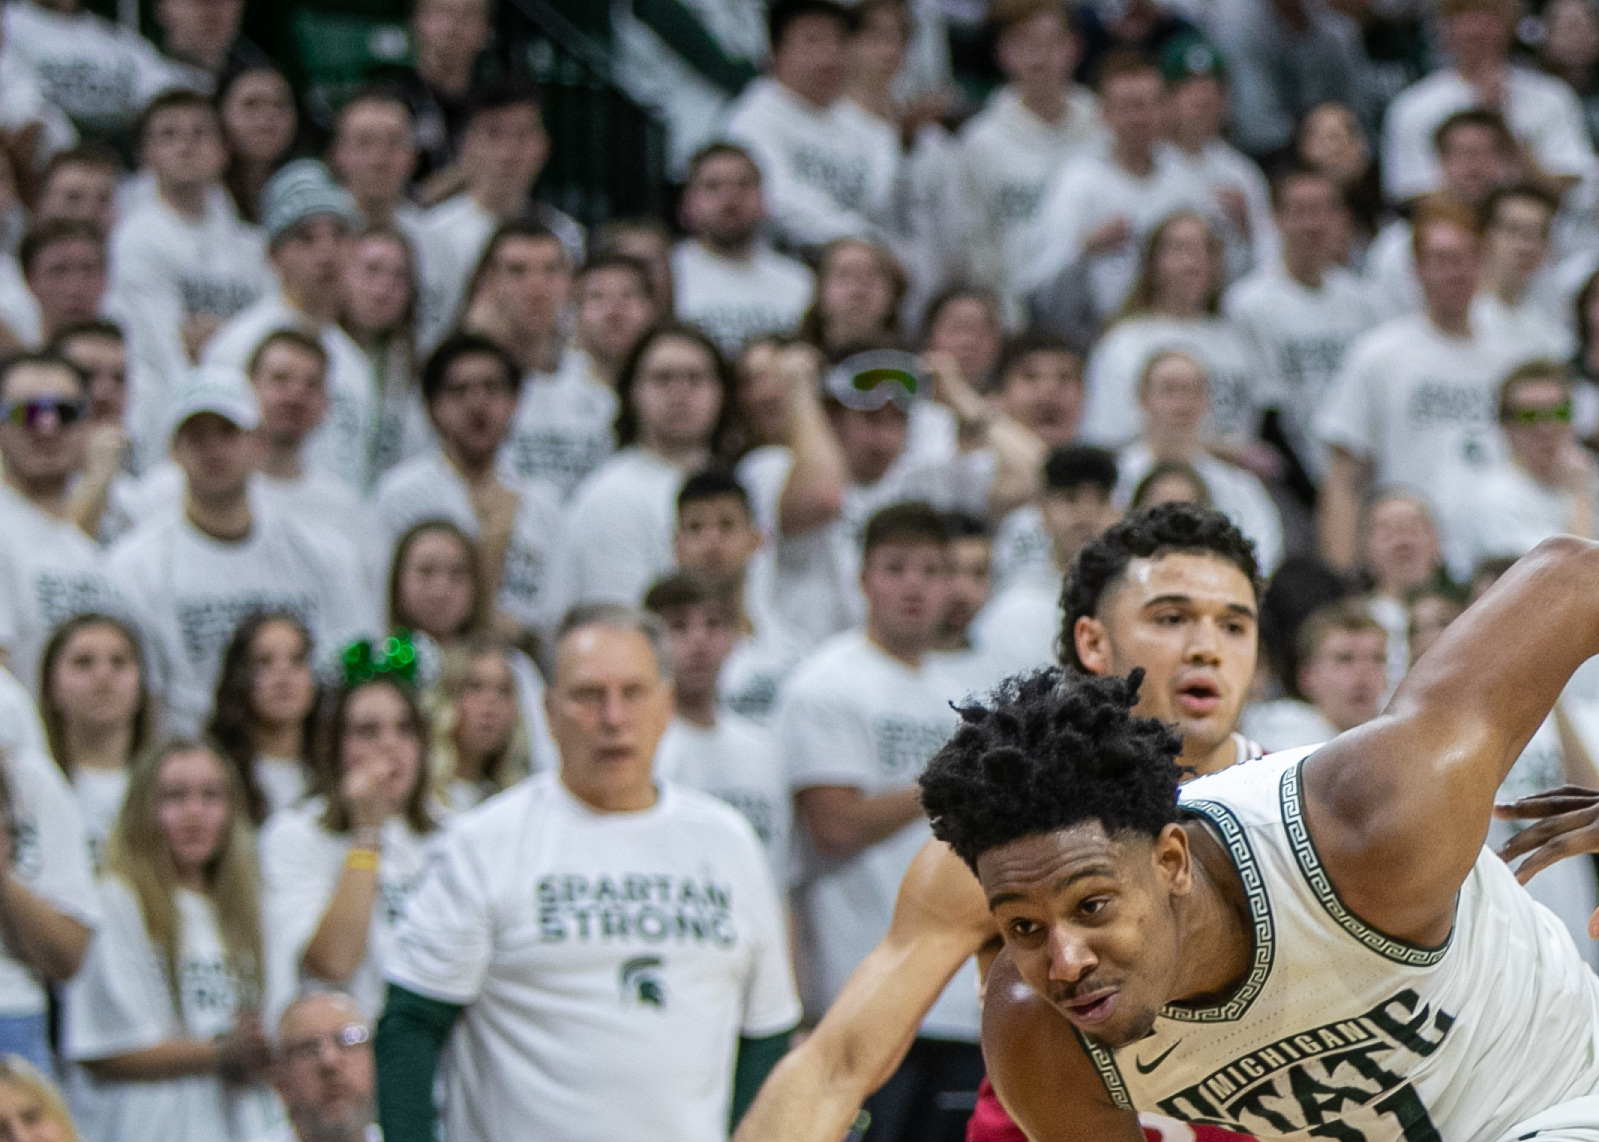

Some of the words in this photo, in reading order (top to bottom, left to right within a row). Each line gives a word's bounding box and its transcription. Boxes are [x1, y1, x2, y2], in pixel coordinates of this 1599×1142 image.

[536, 873, 732, 909] SPARTAN
[538, 905, 737, 947] STRONG
[1156, 987, 1457, 1136] STATE
[1206, 1019, 1368, 1101] MICHIGAN
